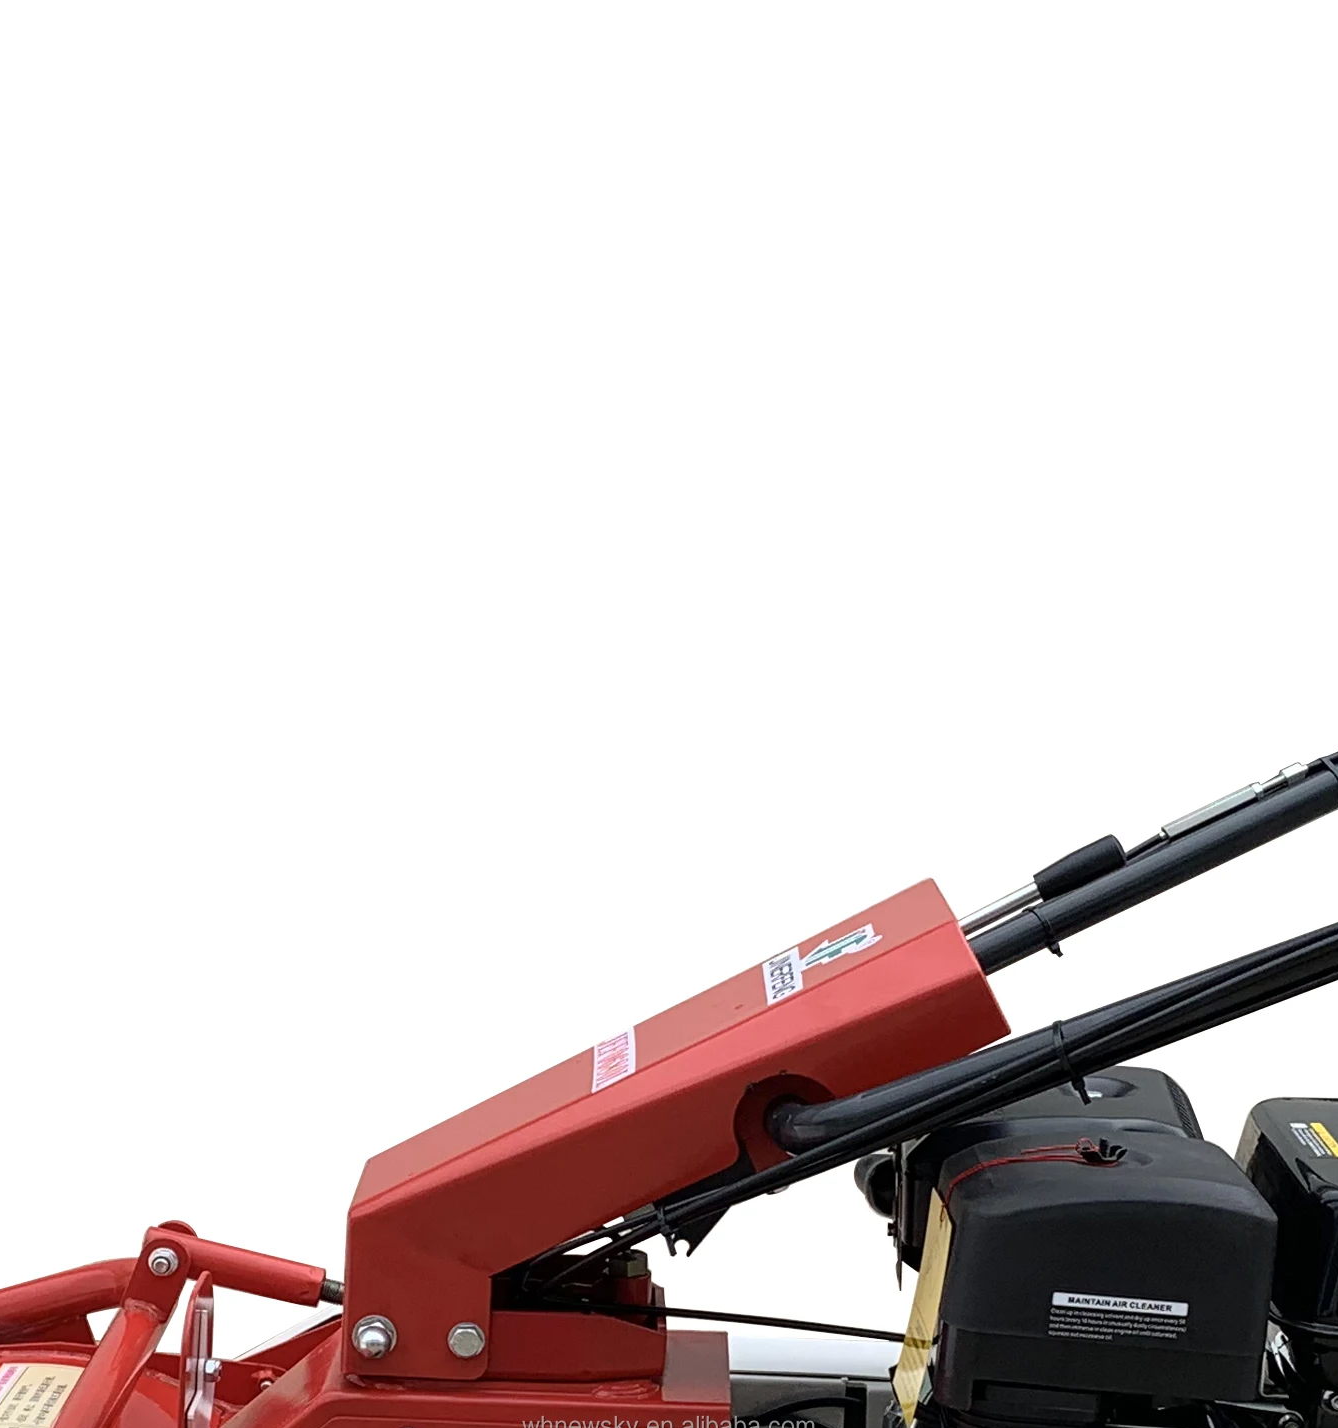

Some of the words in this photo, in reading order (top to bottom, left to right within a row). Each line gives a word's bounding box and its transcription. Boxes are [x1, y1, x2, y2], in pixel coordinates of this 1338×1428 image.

[1068, 1296, 1111, 1307] MAINTAIN
[1112, 1300, 1128, 1309] AIR
[1129, 1301, 1173, 1312] CLEANER
